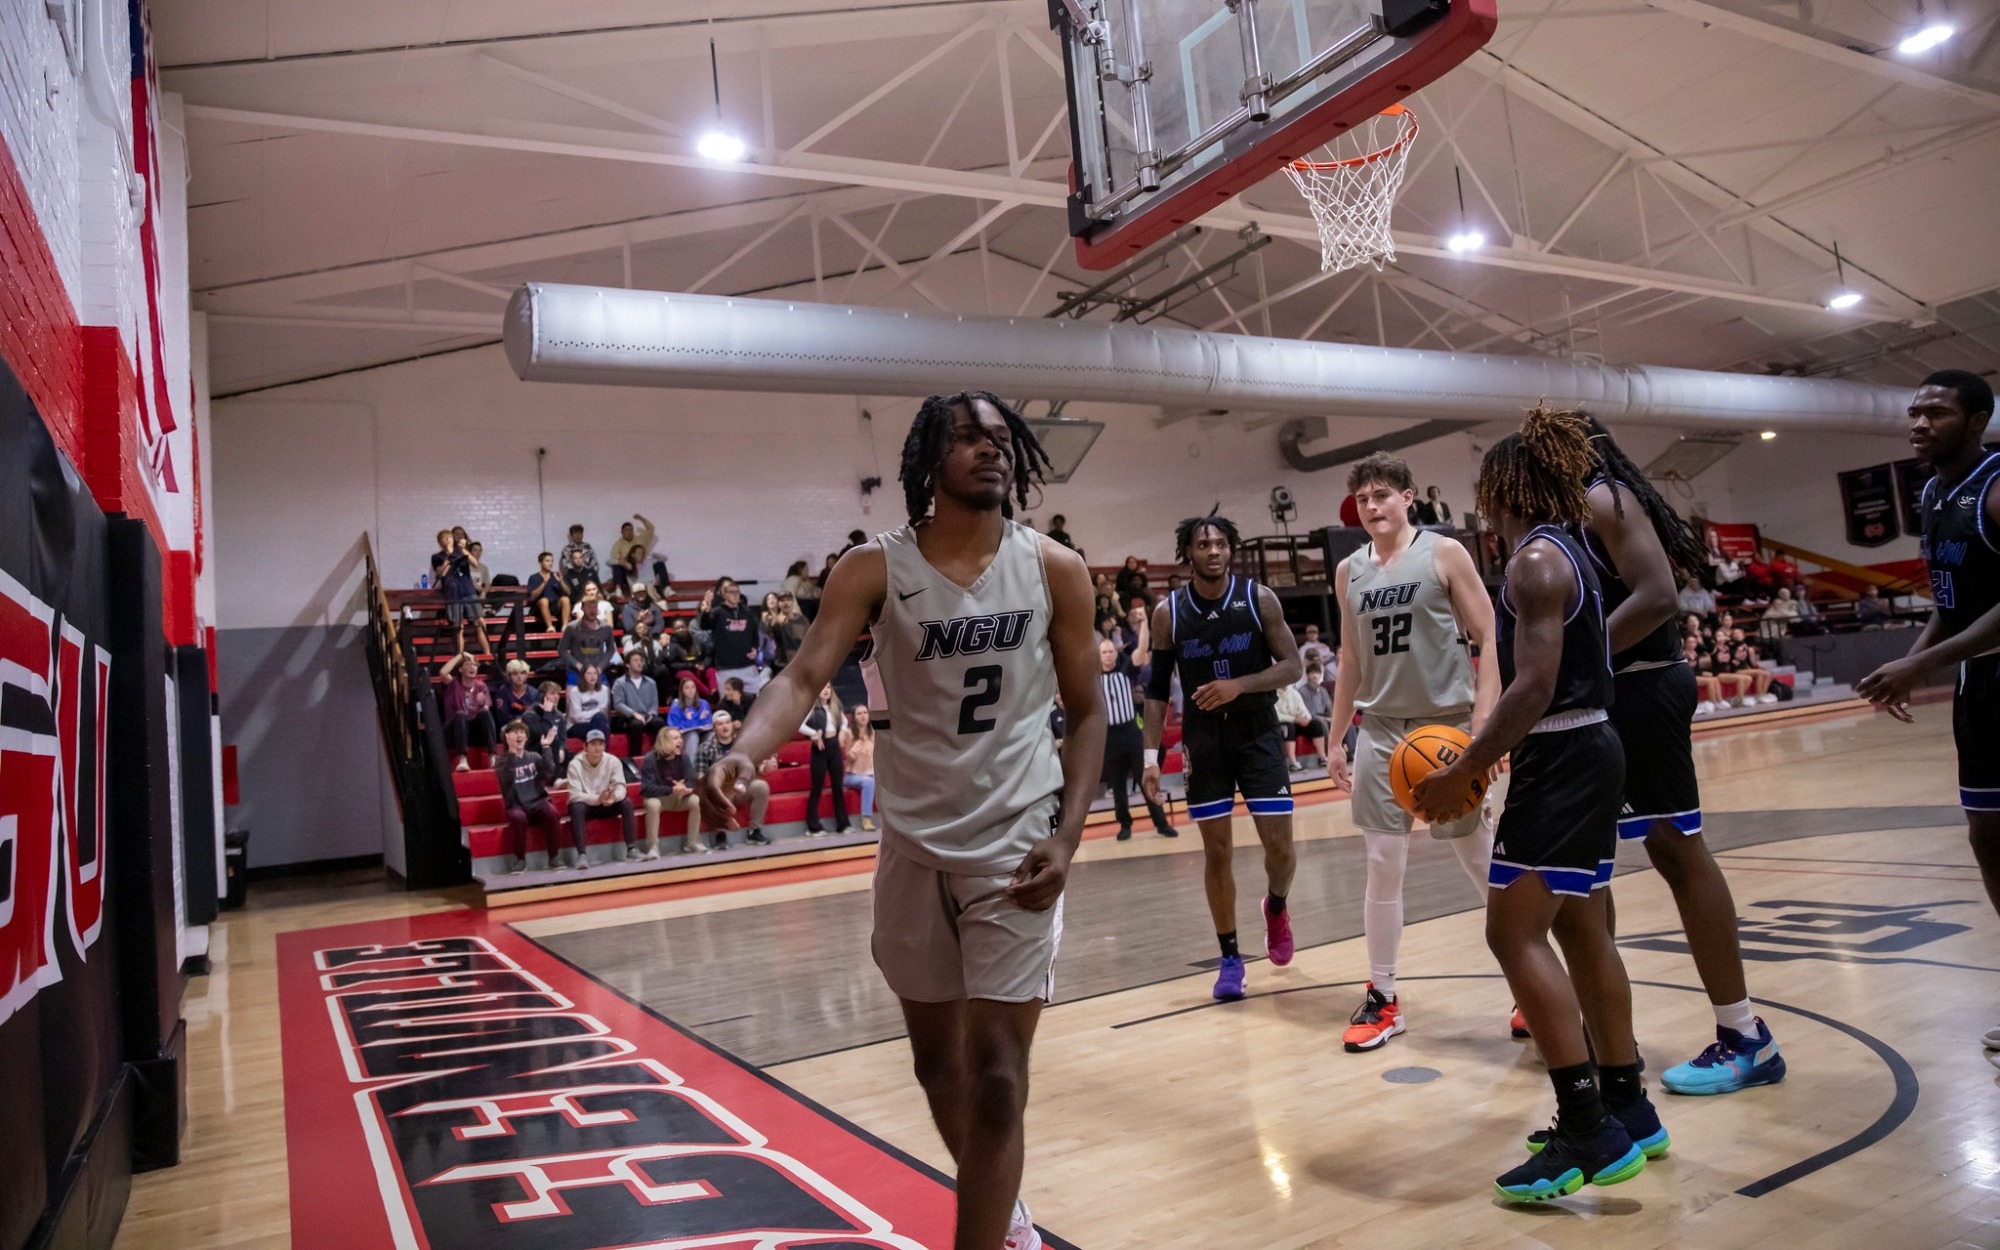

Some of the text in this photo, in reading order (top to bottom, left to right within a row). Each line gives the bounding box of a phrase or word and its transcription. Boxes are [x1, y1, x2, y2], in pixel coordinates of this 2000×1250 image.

[1357, 581, 1421, 615] NGU
[914, 609, 1034, 661] NGU
[1182, 638, 1214, 658] The
[1371, 613, 1413, 656] 32
[1213, 659, 1231, 680] 4
[957, 665, 1003, 735] 2
[313, 936, 935, 1250] EENVILLE
